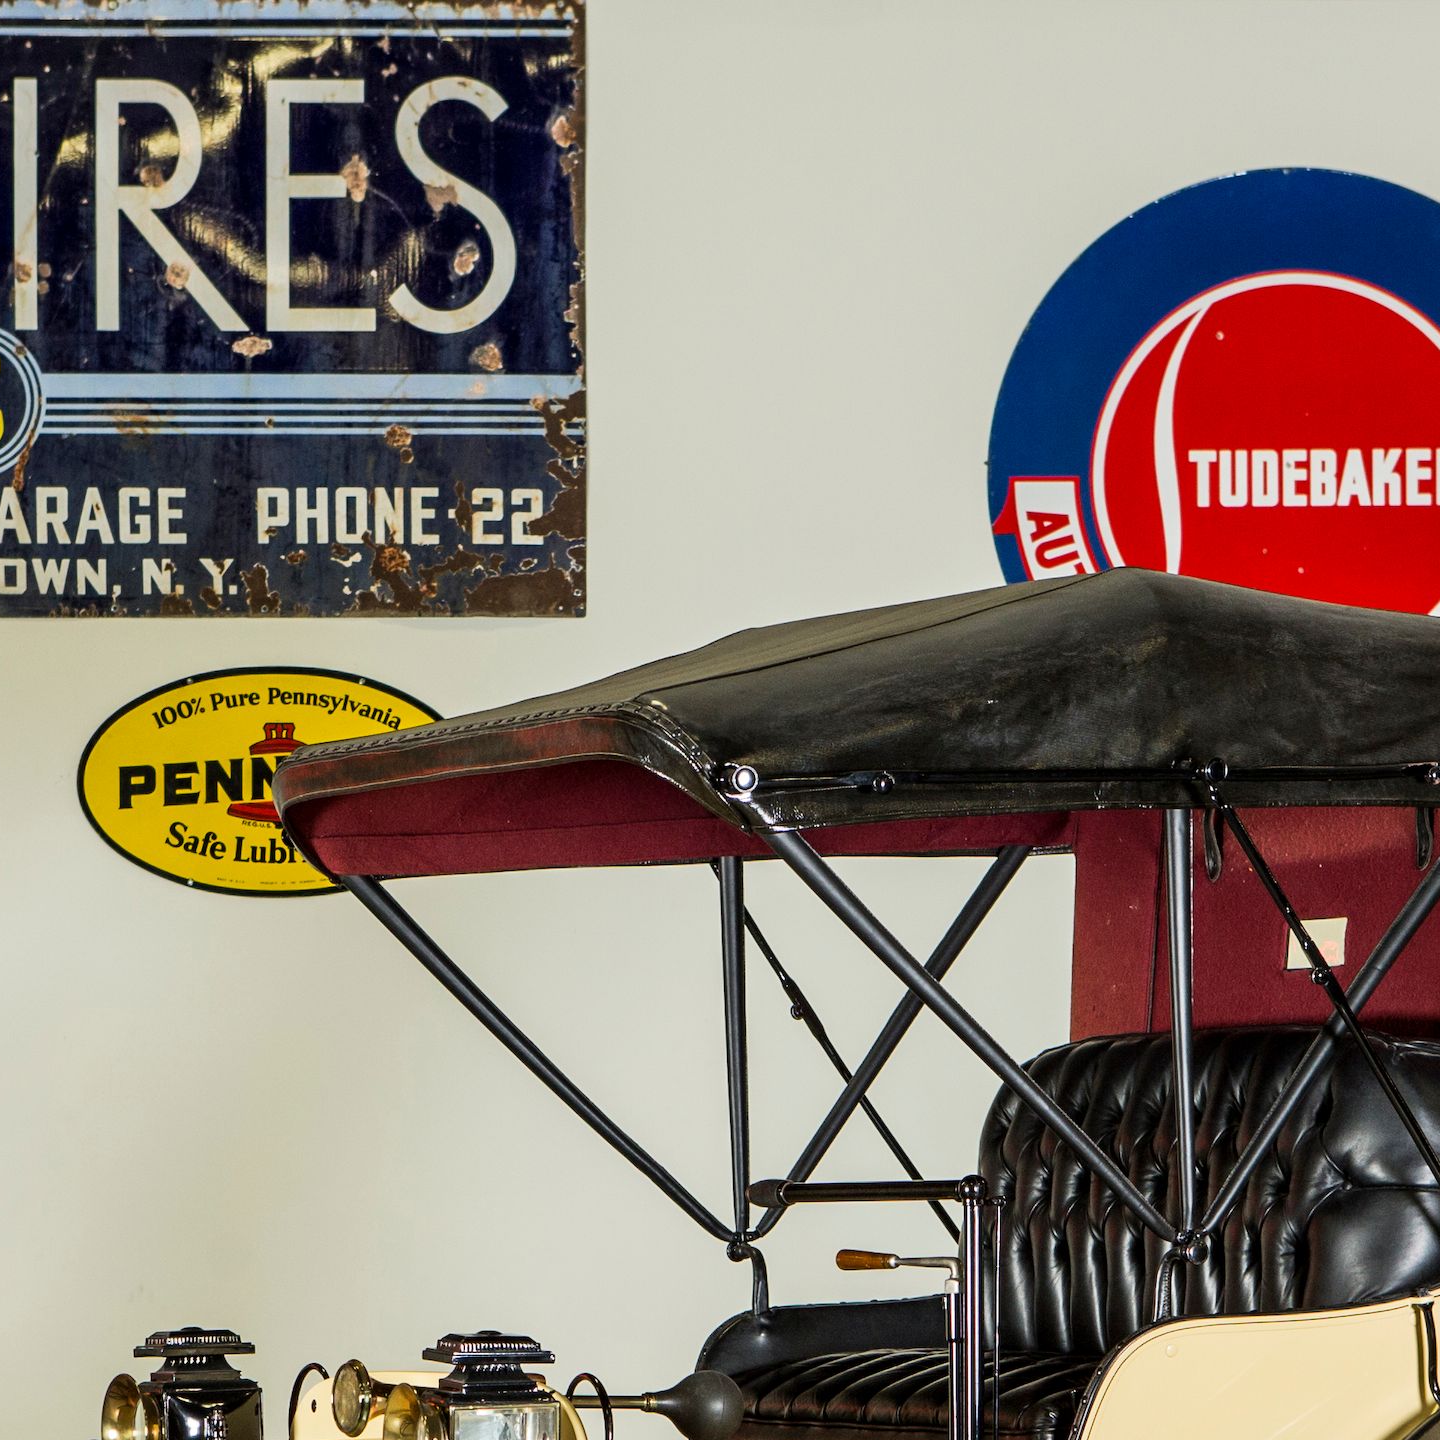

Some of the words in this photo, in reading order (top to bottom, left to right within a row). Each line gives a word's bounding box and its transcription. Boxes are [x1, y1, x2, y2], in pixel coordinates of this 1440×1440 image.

[1026, 511, 1087, 575] AU
[151, 696, 206, 730] 100%
[210, 692, 260, 711] Pure
[268, 687, 401, 730] Pennsylvania
[164, 821, 227, 860] Safe
[233, 835, 307, 864] Lubr
